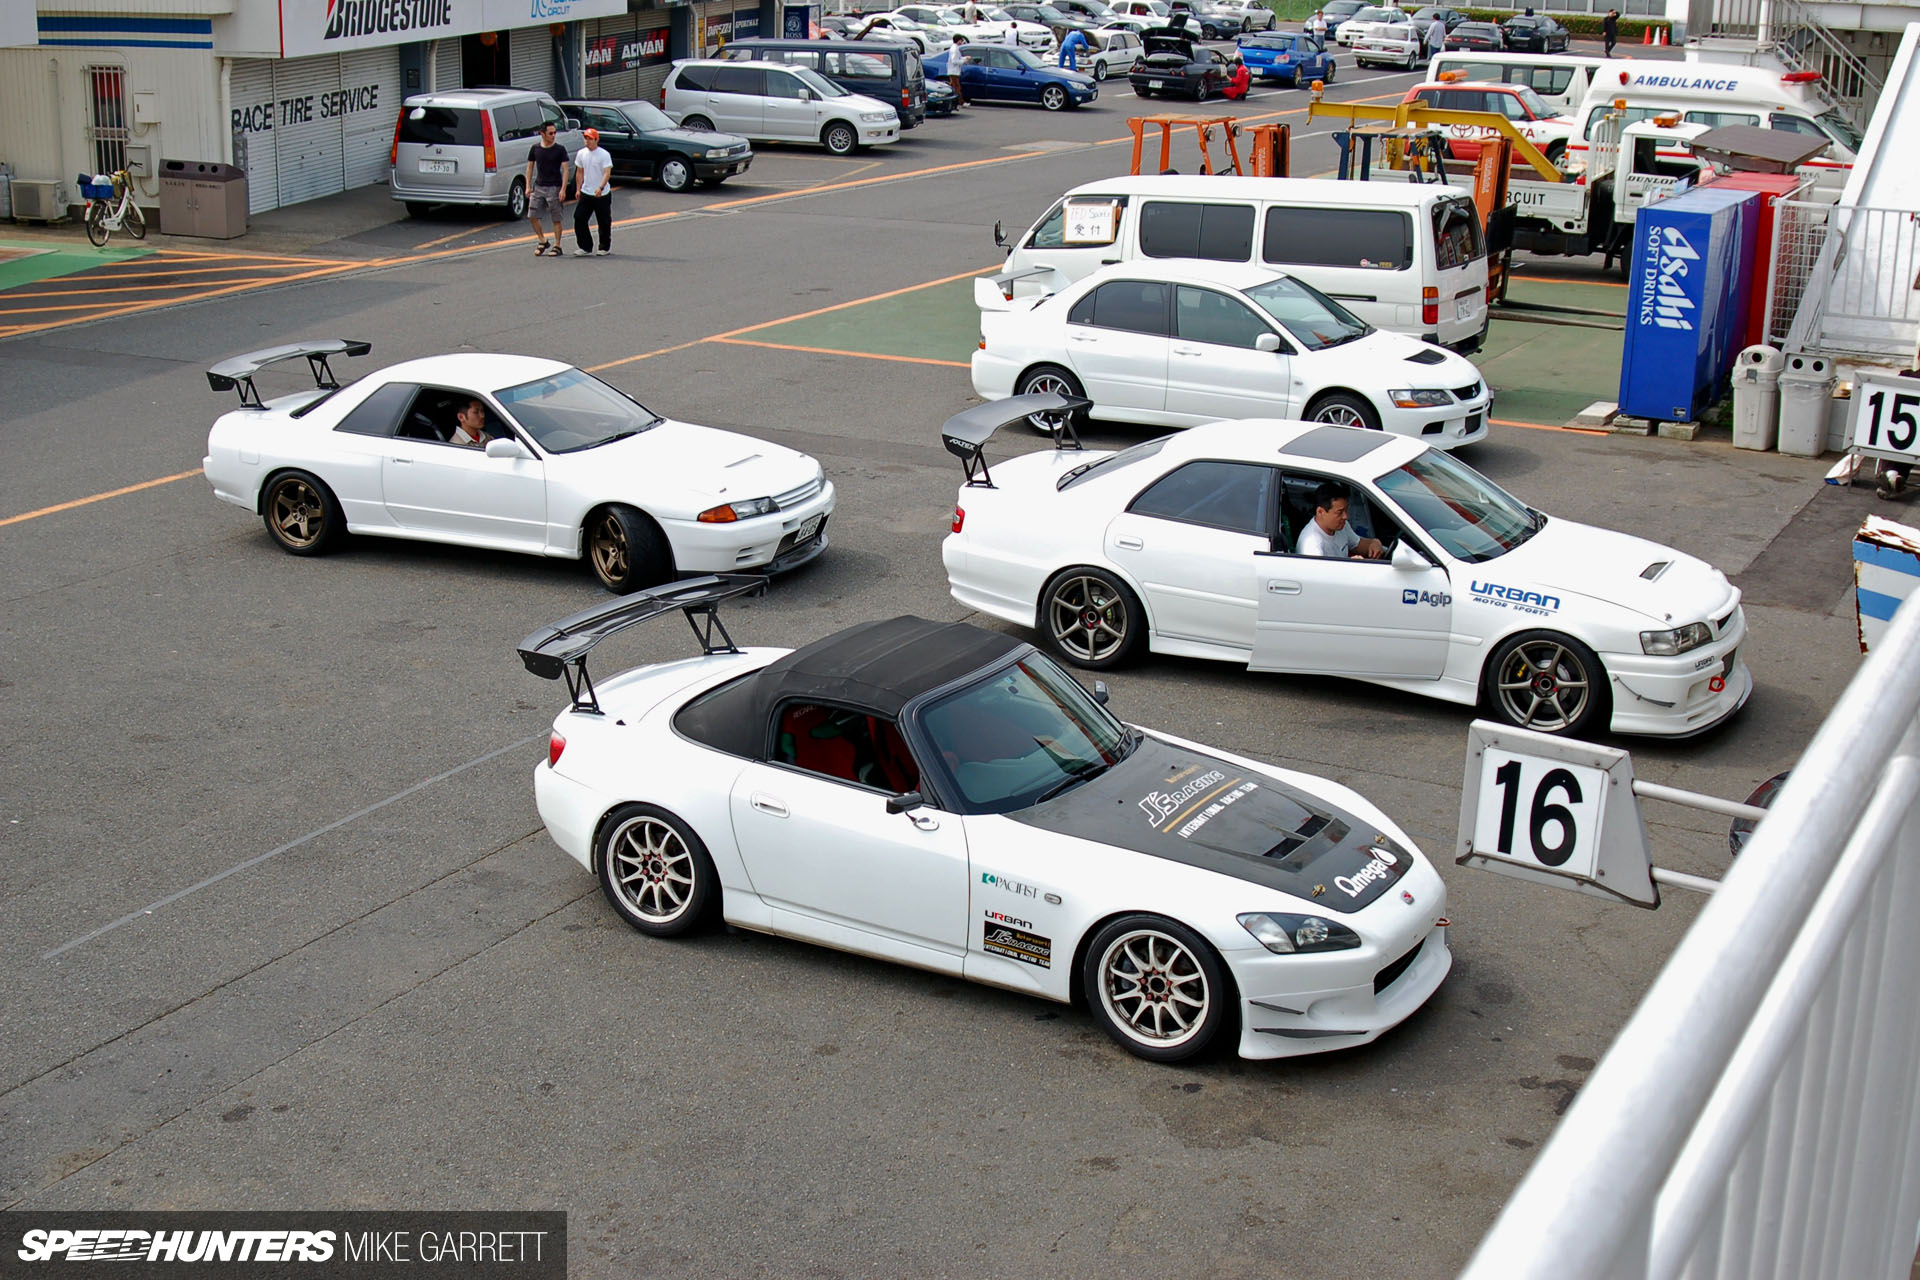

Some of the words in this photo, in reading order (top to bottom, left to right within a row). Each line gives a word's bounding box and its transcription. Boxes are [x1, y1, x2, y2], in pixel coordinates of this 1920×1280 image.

[324, 0, 452, 40] BRIDGESTONE
[547, 5, 571, 17] CIRCUIT
[584, 48, 612, 66] VAN
[621, 39, 664, 60] ADVAN
[1634, 75, 1738, 92] AMBULANCE
[232, 103, 274, 133] RACE
[280, 96, 314, 126] TIRE
[320, 84, 379, 119] SERVICE
[1478, 124, 1535, 139] TOTA
[1627, 175, 1678, 185] DUNLOP
[1506, 191, 1547, 206] RCUIT
[1646, 225, 1662, 266] SOFT
[1654, 226, 1701, 331] Asahi
[1640, 267, 1658, 326] DRINKS
[1868, 391, 1920, 451] 15
[1420, 590, 1452, 608] Agip
[1470, 580, 1561, 610] URBAN
[1473, 596, 1508, 608] MOTOR
[1513, 604, 1550, 617] SPORTS
[1496, 760, 1583, 867] 16
[984, 909, 1033, 930] URBAN
